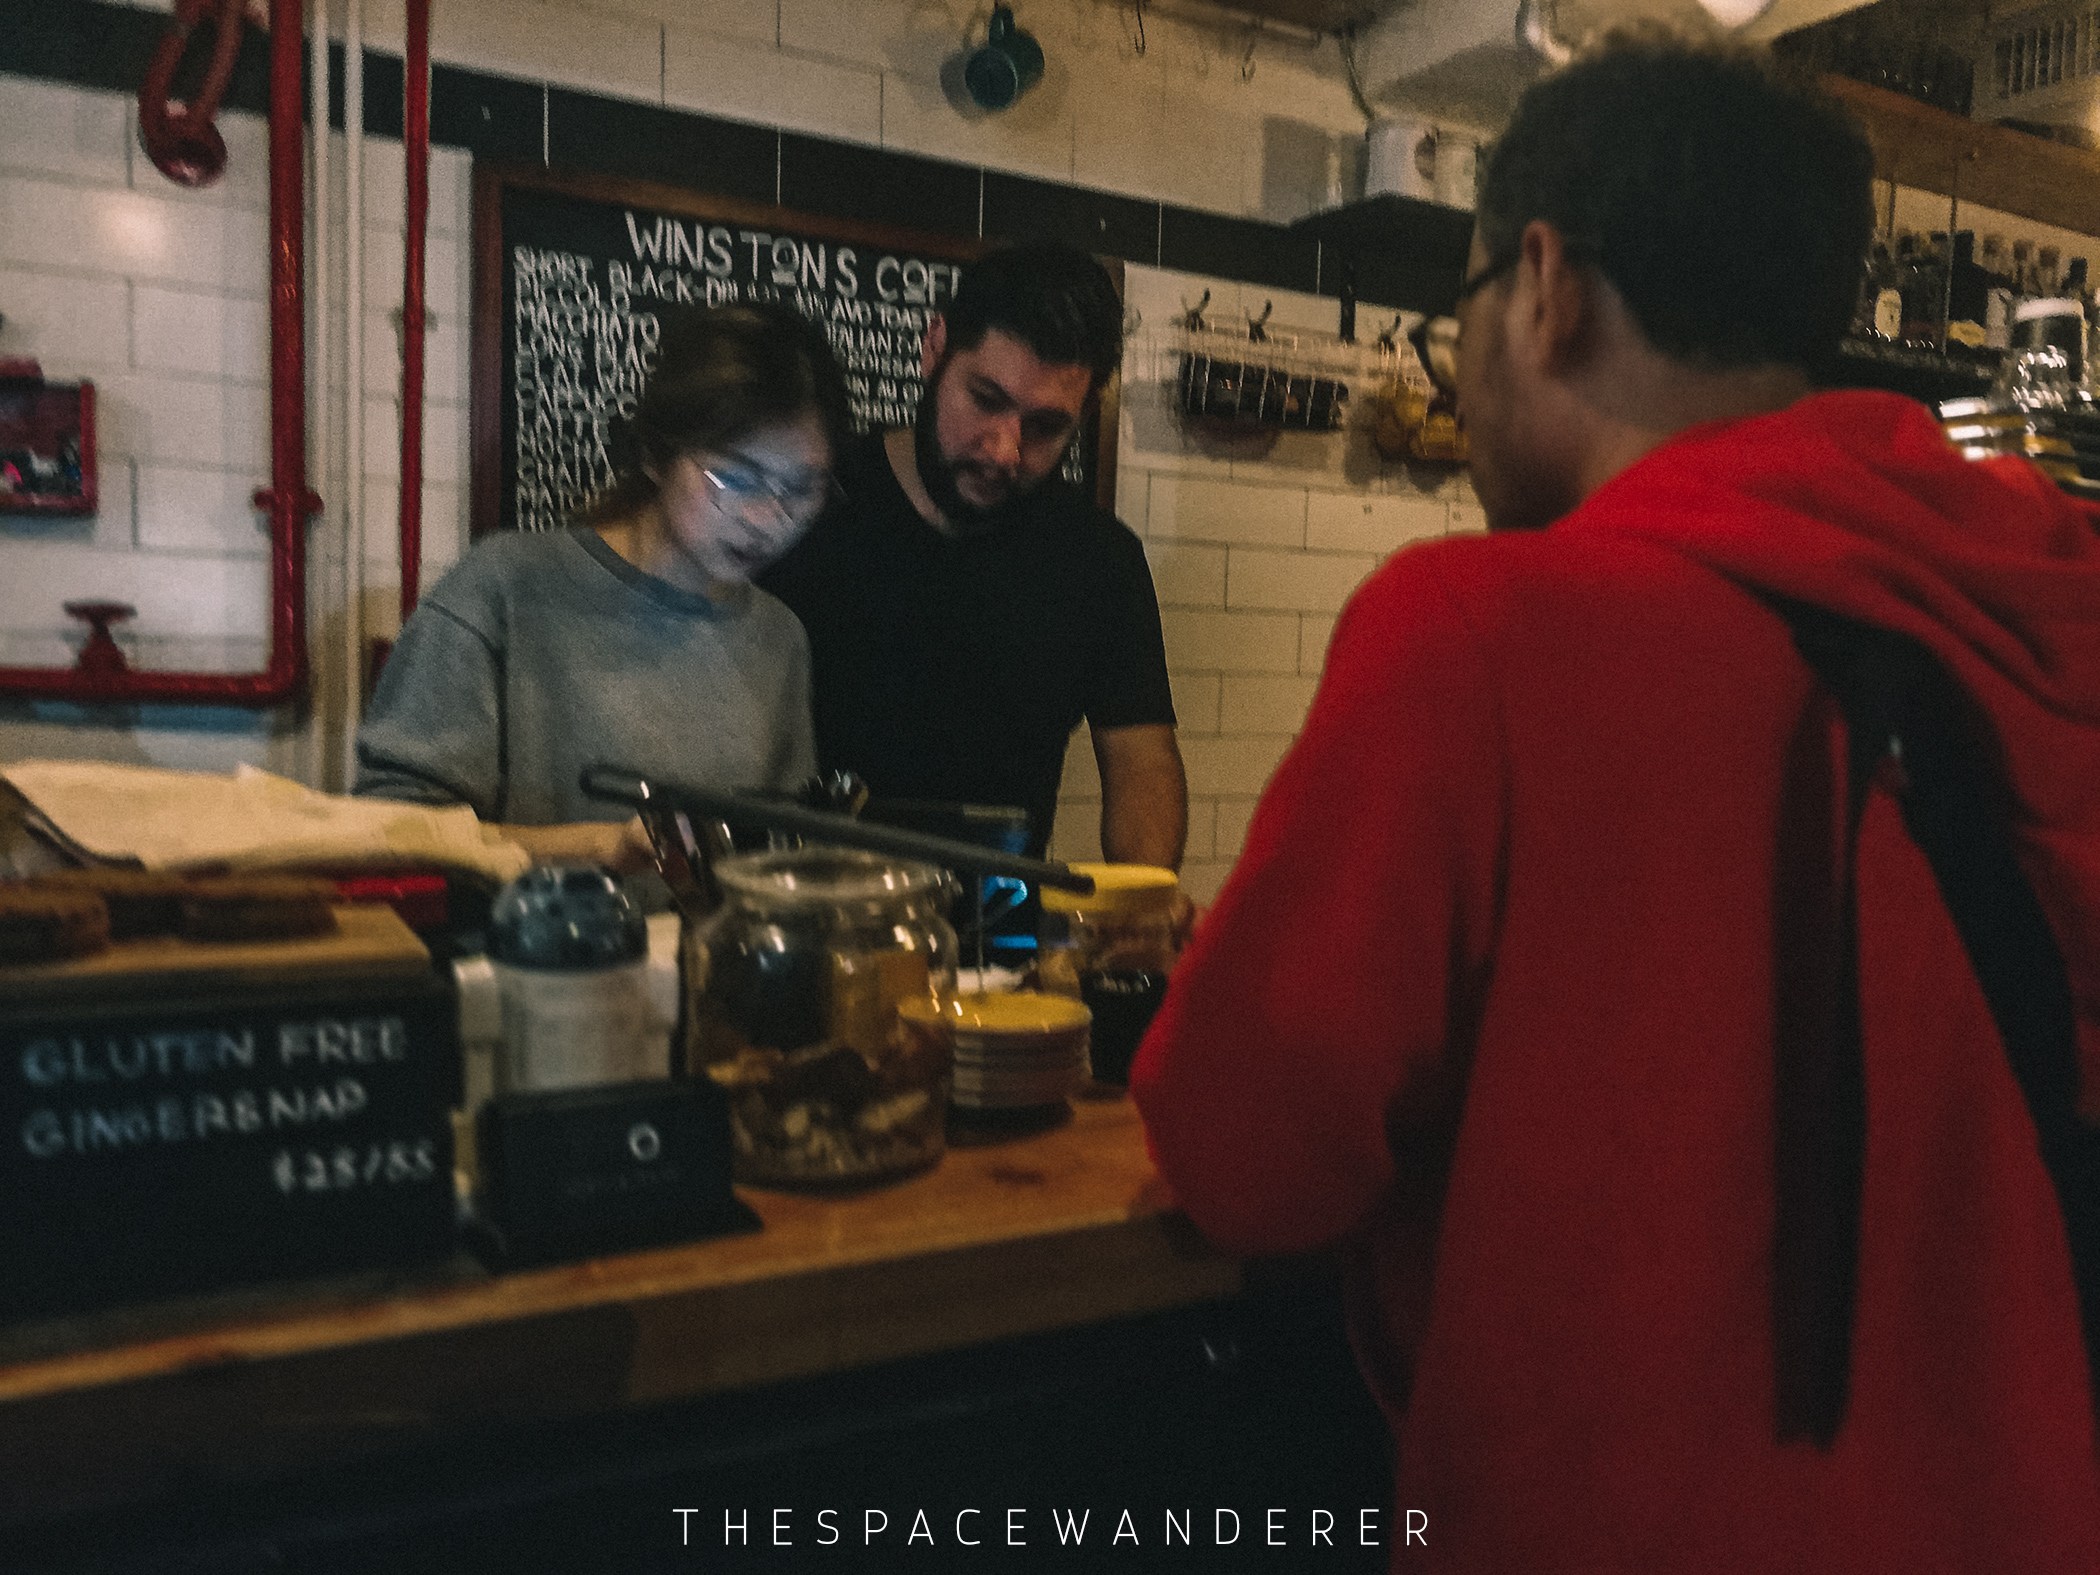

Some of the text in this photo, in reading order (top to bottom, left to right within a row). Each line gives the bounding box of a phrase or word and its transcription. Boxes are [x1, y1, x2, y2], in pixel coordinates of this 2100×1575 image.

[514, 246, 593, 290] SHORT
[515, 297, 661, 352] MACCHIATO
[20, 1017, 407, 1086] GLUTEN FREE
